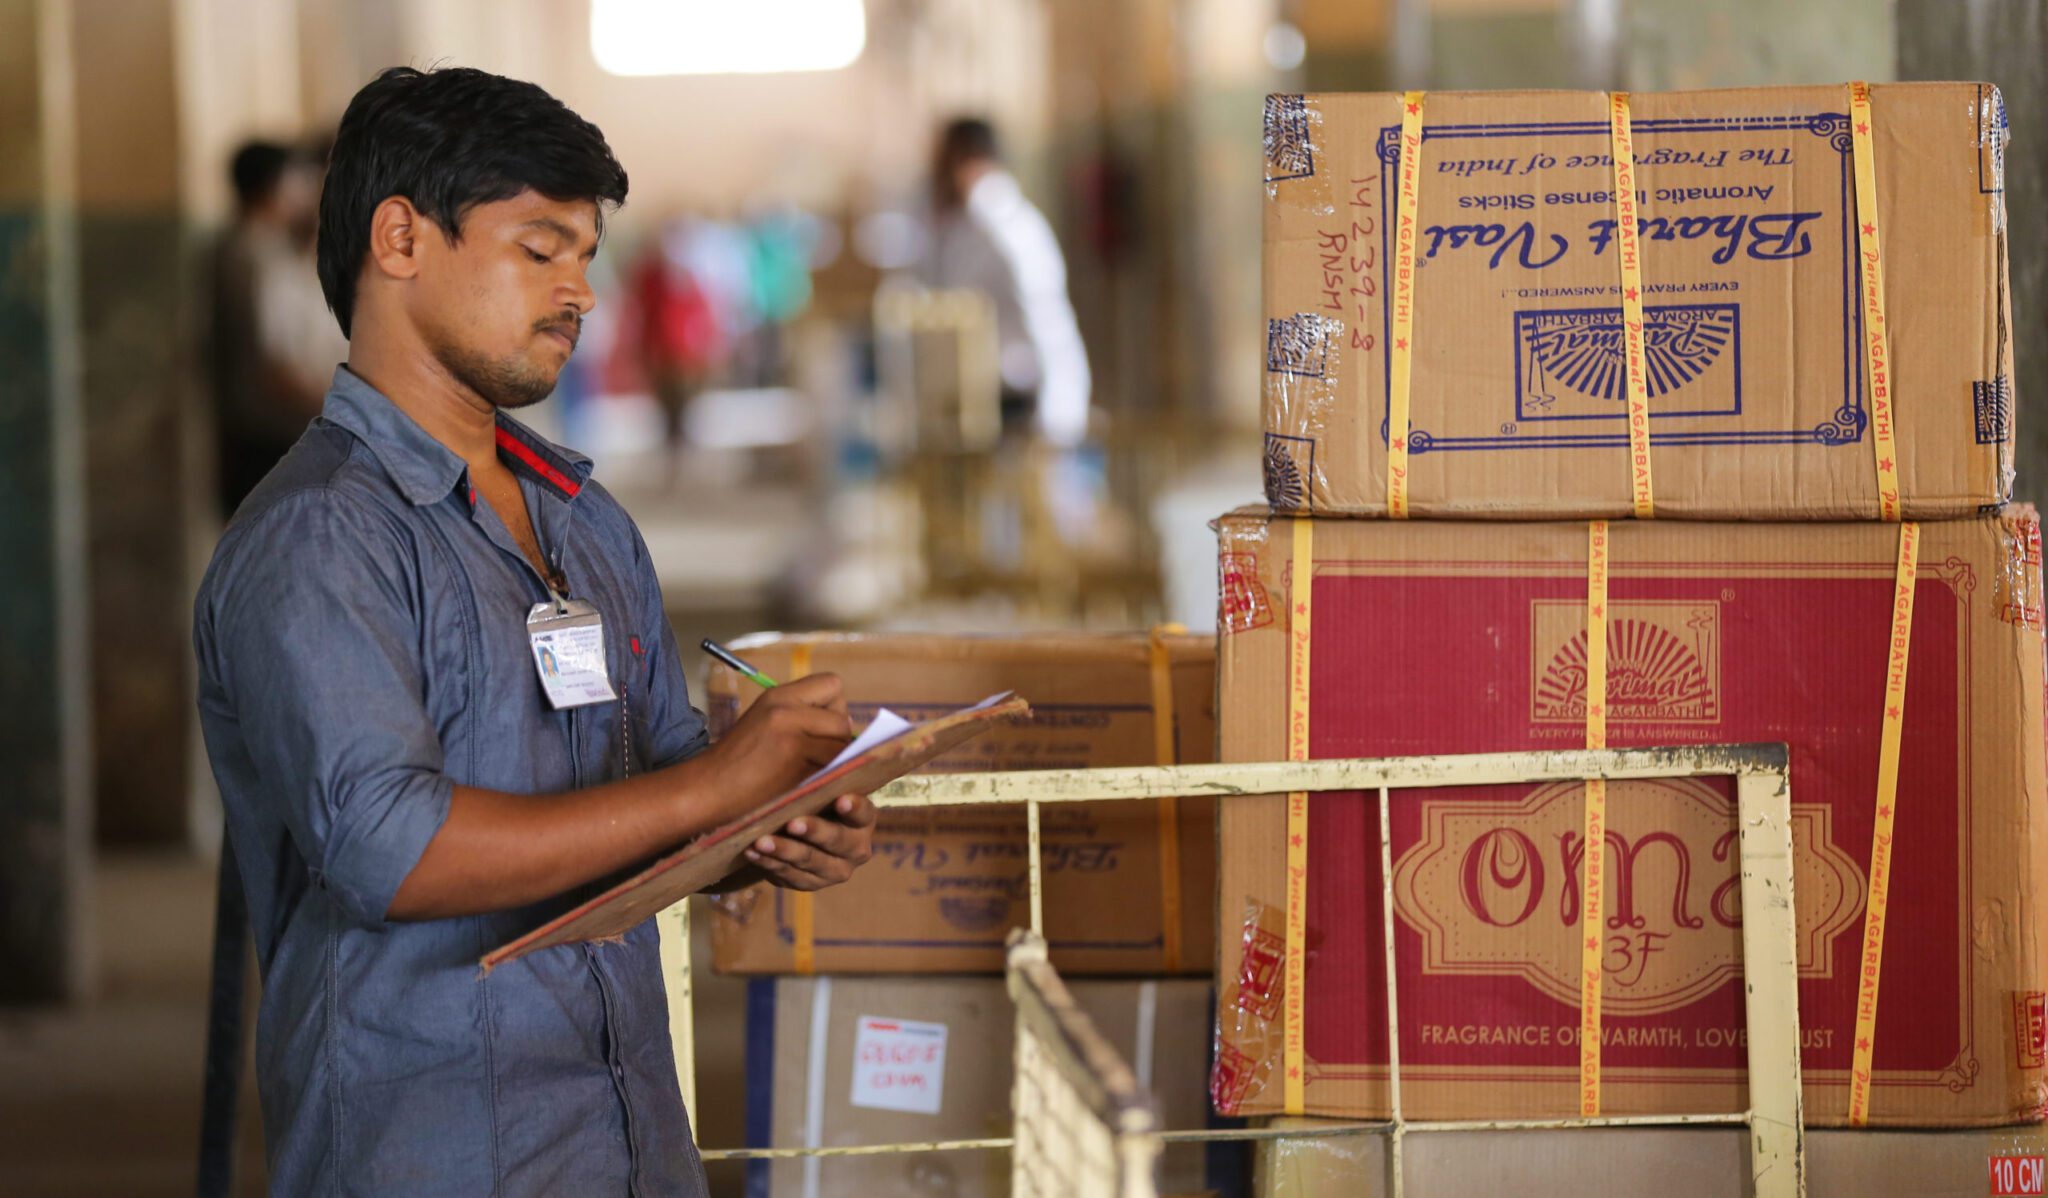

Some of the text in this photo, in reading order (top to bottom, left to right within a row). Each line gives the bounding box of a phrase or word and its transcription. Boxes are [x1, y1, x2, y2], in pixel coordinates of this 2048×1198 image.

[1438, 148, 1794, 177] The Fragrnce of India
[1397, 133, 1420, 323] Parimal AGARBATHI
[1458, 185, 1774, 210] Aromatic Icense Sticks
[1618, 160, 1636, 271] AGARBATHI
[1424, 221, 1569, 270] Vasi
[1650, 310, 1717, 323] AROMA
[1690, 281, 1740, 292] EVERY
[1862, 248, 1889, 441] Parimal AGARBATHI
[1626, 318, 1649, 510] Parimal AGARBATHI
[1592, 522, 1605, 591] RBATHI
[1890, 584, 1910, 693] AGARBATHI
[1555, 663, 1693, 705] Primal
[1611, 703, 1702, 719] AGARBATHI
[1587, 811, 1601, 920] AGARBATHI
[1860, 833, 1892, 1021] Parimal AGARBATHI
[1600, 931, 1672, 988] 3F
[1288, 946, 1300, 1052] AGARBATHI
[1421, 1025, 1550, 1046] FRAGRANCE
[1800, 1029, 1834, 1049] UST
[1584, 1049, 1596, 1115] AGARB
[1994, 1158, 2045, 1193] 10 CM
